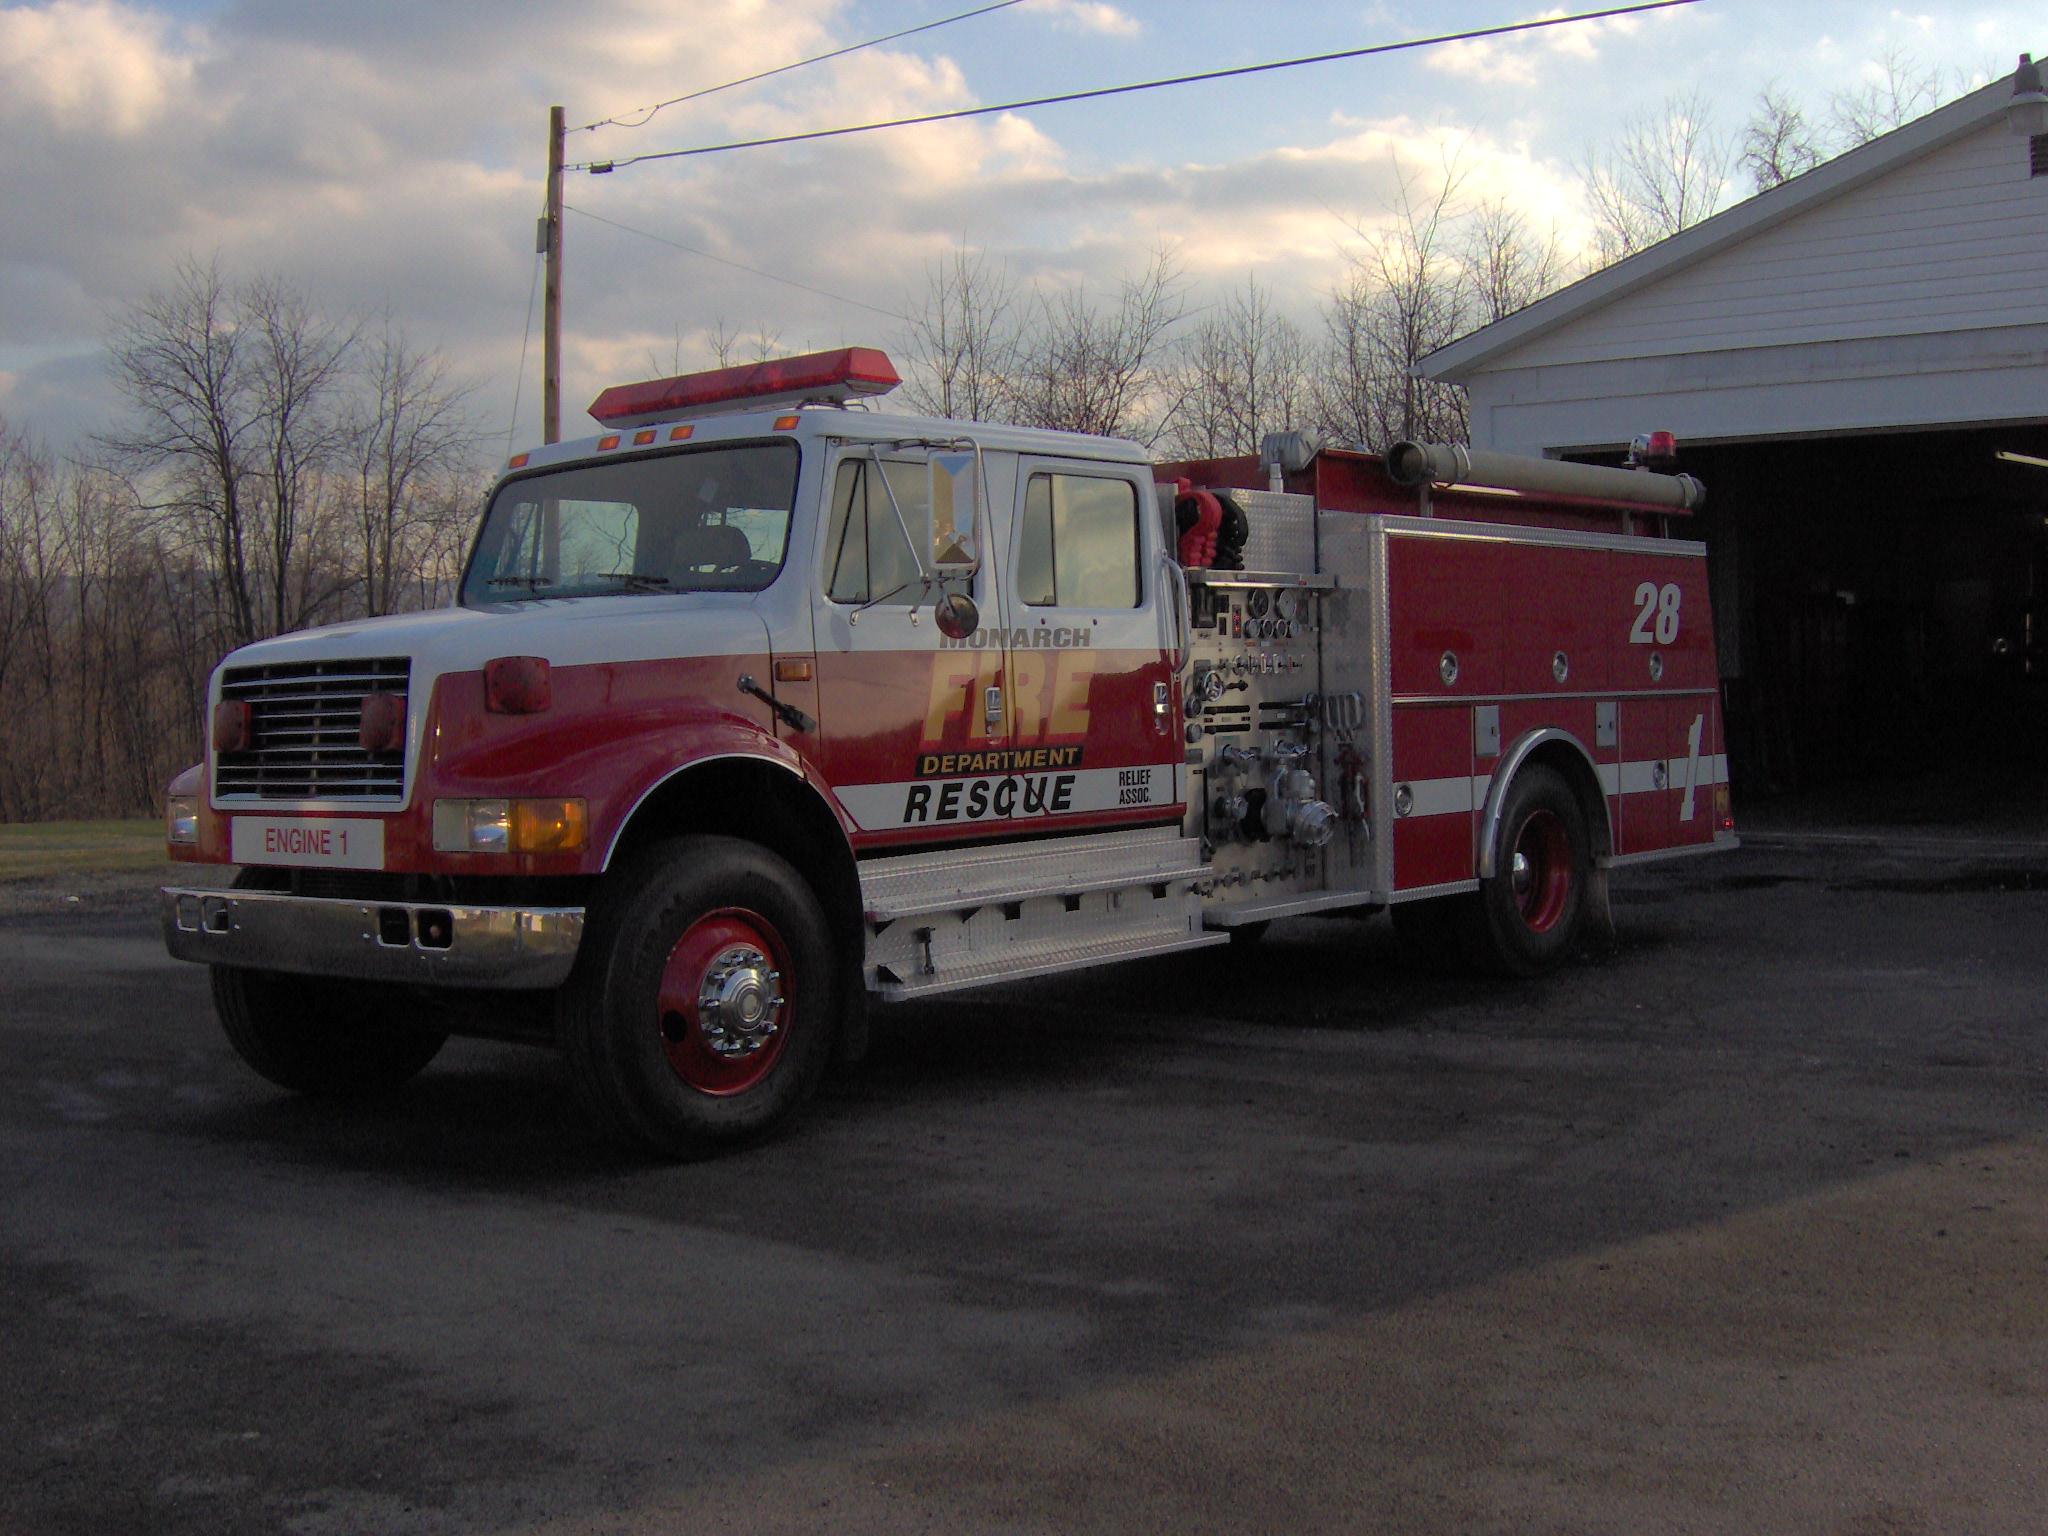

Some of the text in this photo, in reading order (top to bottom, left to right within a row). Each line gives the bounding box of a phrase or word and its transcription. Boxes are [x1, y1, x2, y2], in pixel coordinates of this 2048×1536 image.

[1629, 581, 1682, 645] 28
[923, 650, 1098, 742] FIRE
[922, 747, 1079, 774] DEPARTMENT
[1119, 769, 1151, 787] RELIEF
[1679, 713, 1704, 822] 1
[903, 774, 1076, 823] RESCUE
[265, 828, 347, 855] ENGINE 1
